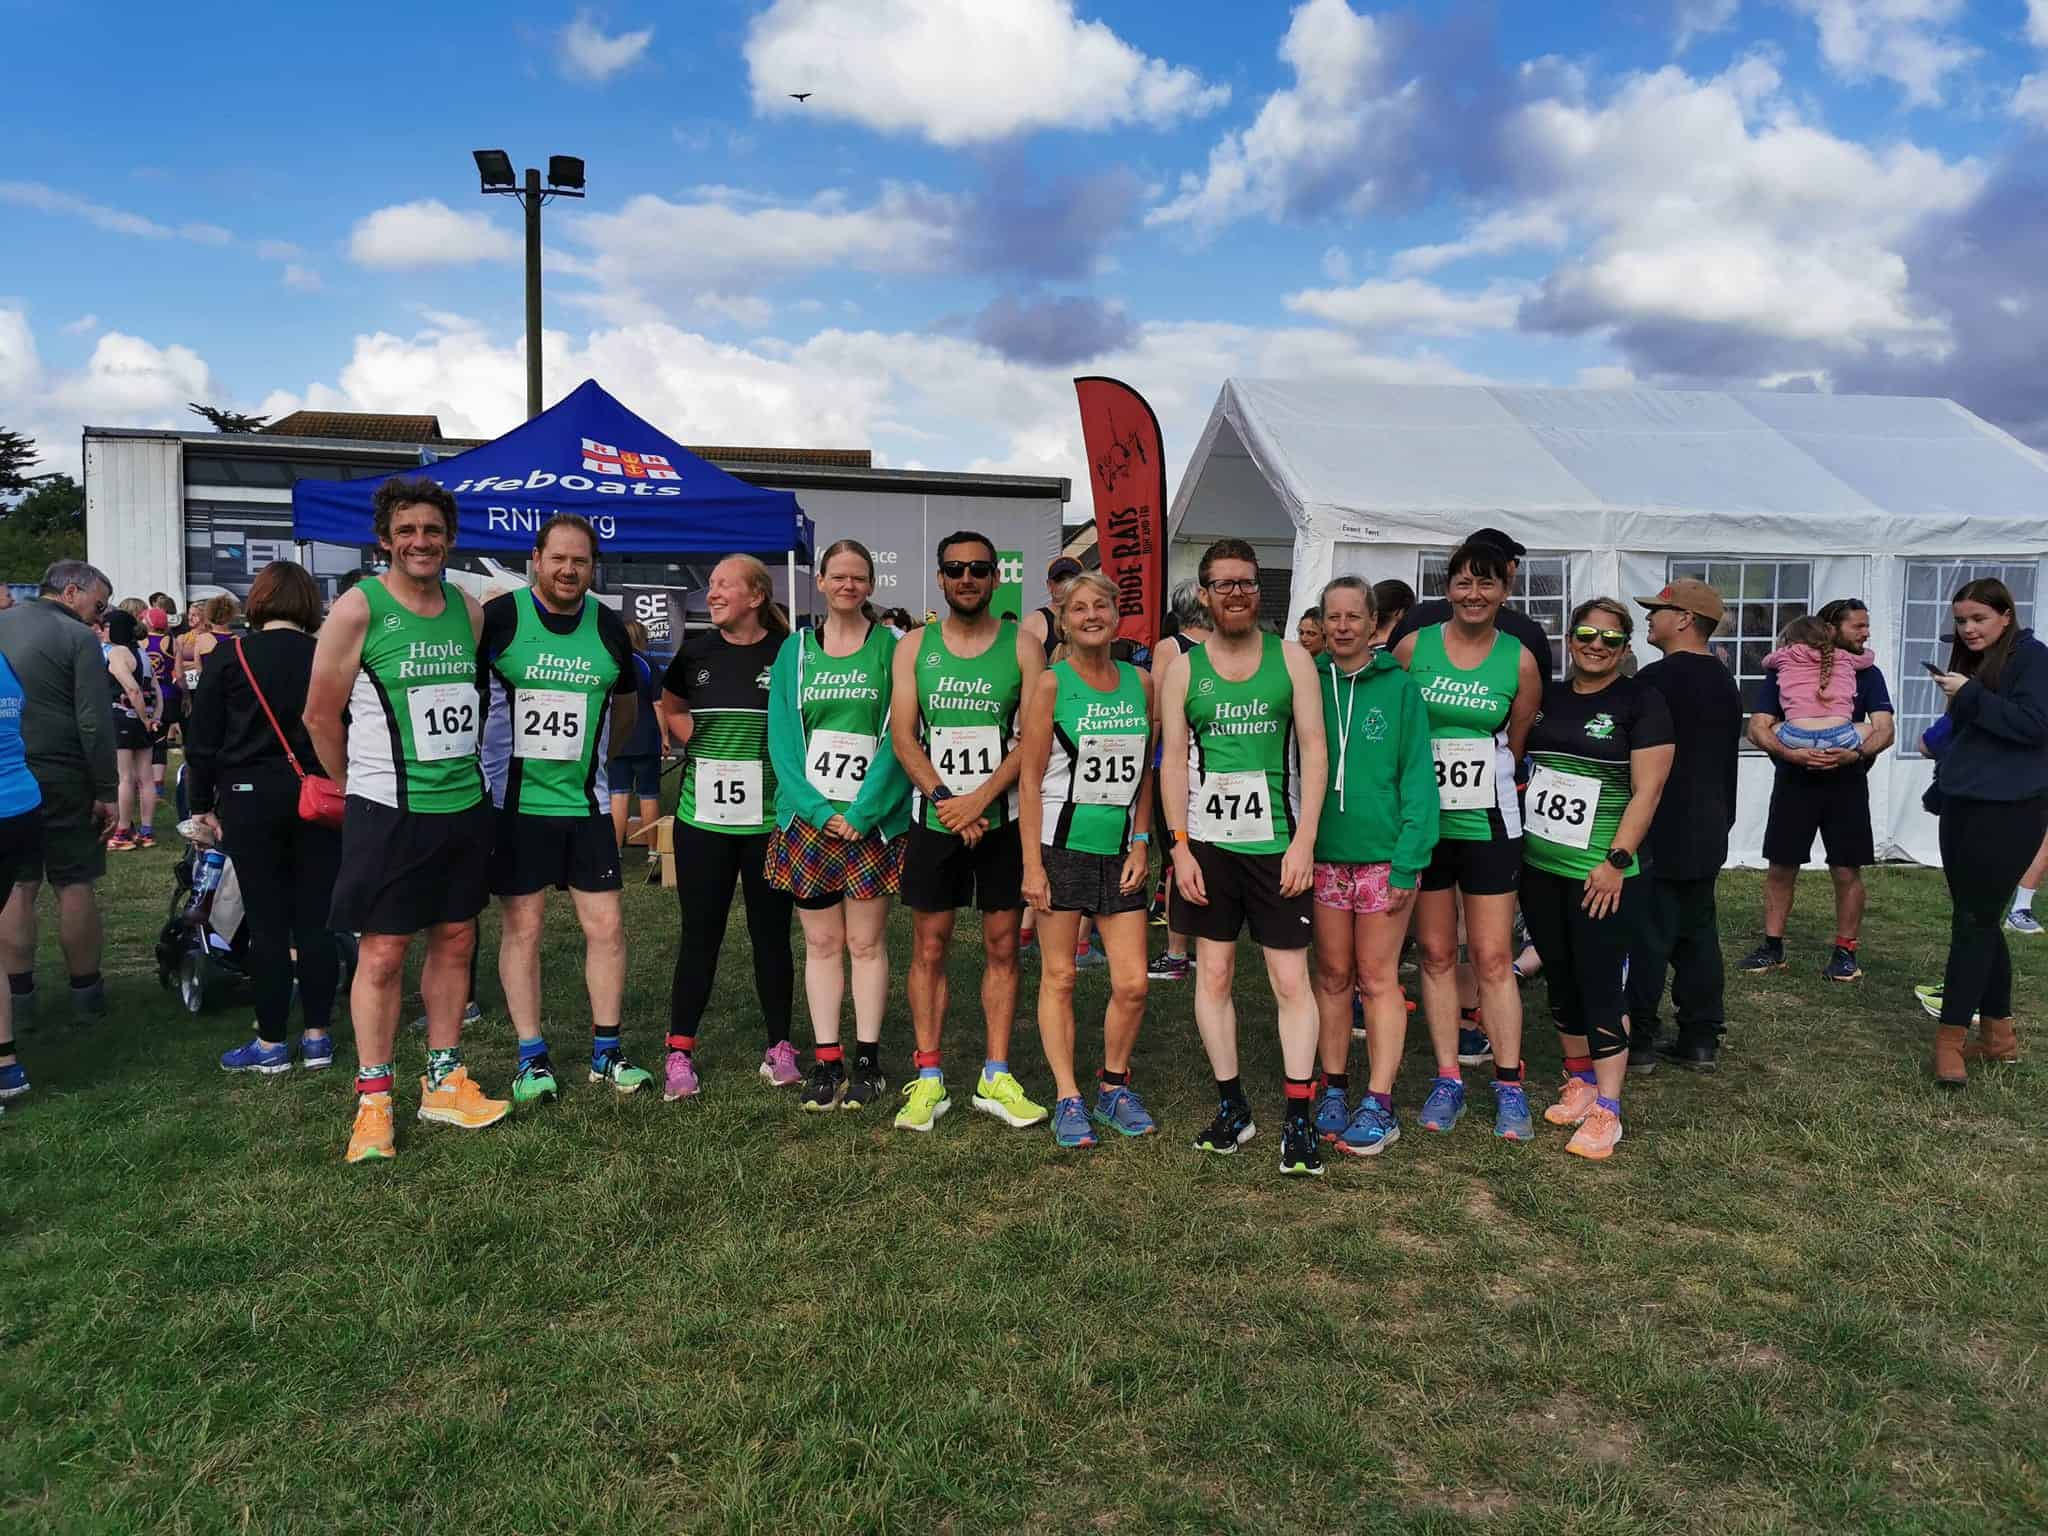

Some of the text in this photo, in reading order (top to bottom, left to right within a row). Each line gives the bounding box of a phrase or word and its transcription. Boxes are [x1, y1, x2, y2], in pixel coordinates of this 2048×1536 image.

[436, 469, 681, 496] ifeboats
[1108, 506, 1144, 617] BUDE RATS
[635, 594, 668, 619] SE
[410, 640, 464, 660] Hayle
[536, 653, 592, 671] Hayle
[399, 660, 477, 679] Runners
[524, 665, 601, 686] Runners
[812, 669, 868, 687] Hayle
[803, 686, 879, 702] Runners
[936, 676, 992, 697] Hayle
[1430, 675, 1489, 696] Hayle
[929, 693, 1000, 713] Runners
[1086, 700, 1135, 719] Hayle
[1215, 698, 1269, 721] Hayle
[425, 704, 473, 736] 162
[524, 710, 578, 738] 245
[1208, 720, 1278, 737] Runners
[814, 751, 868, 782] 473
[940, 747, 993, 775] 411
[1083, 755, 1136, 783] 315
[1434, 760, 1486, 788] 367
[713, 780, 746, 805] 15
[1205, 791, 1264, 821] 474
[1534, 790, 1587, 826] 183
